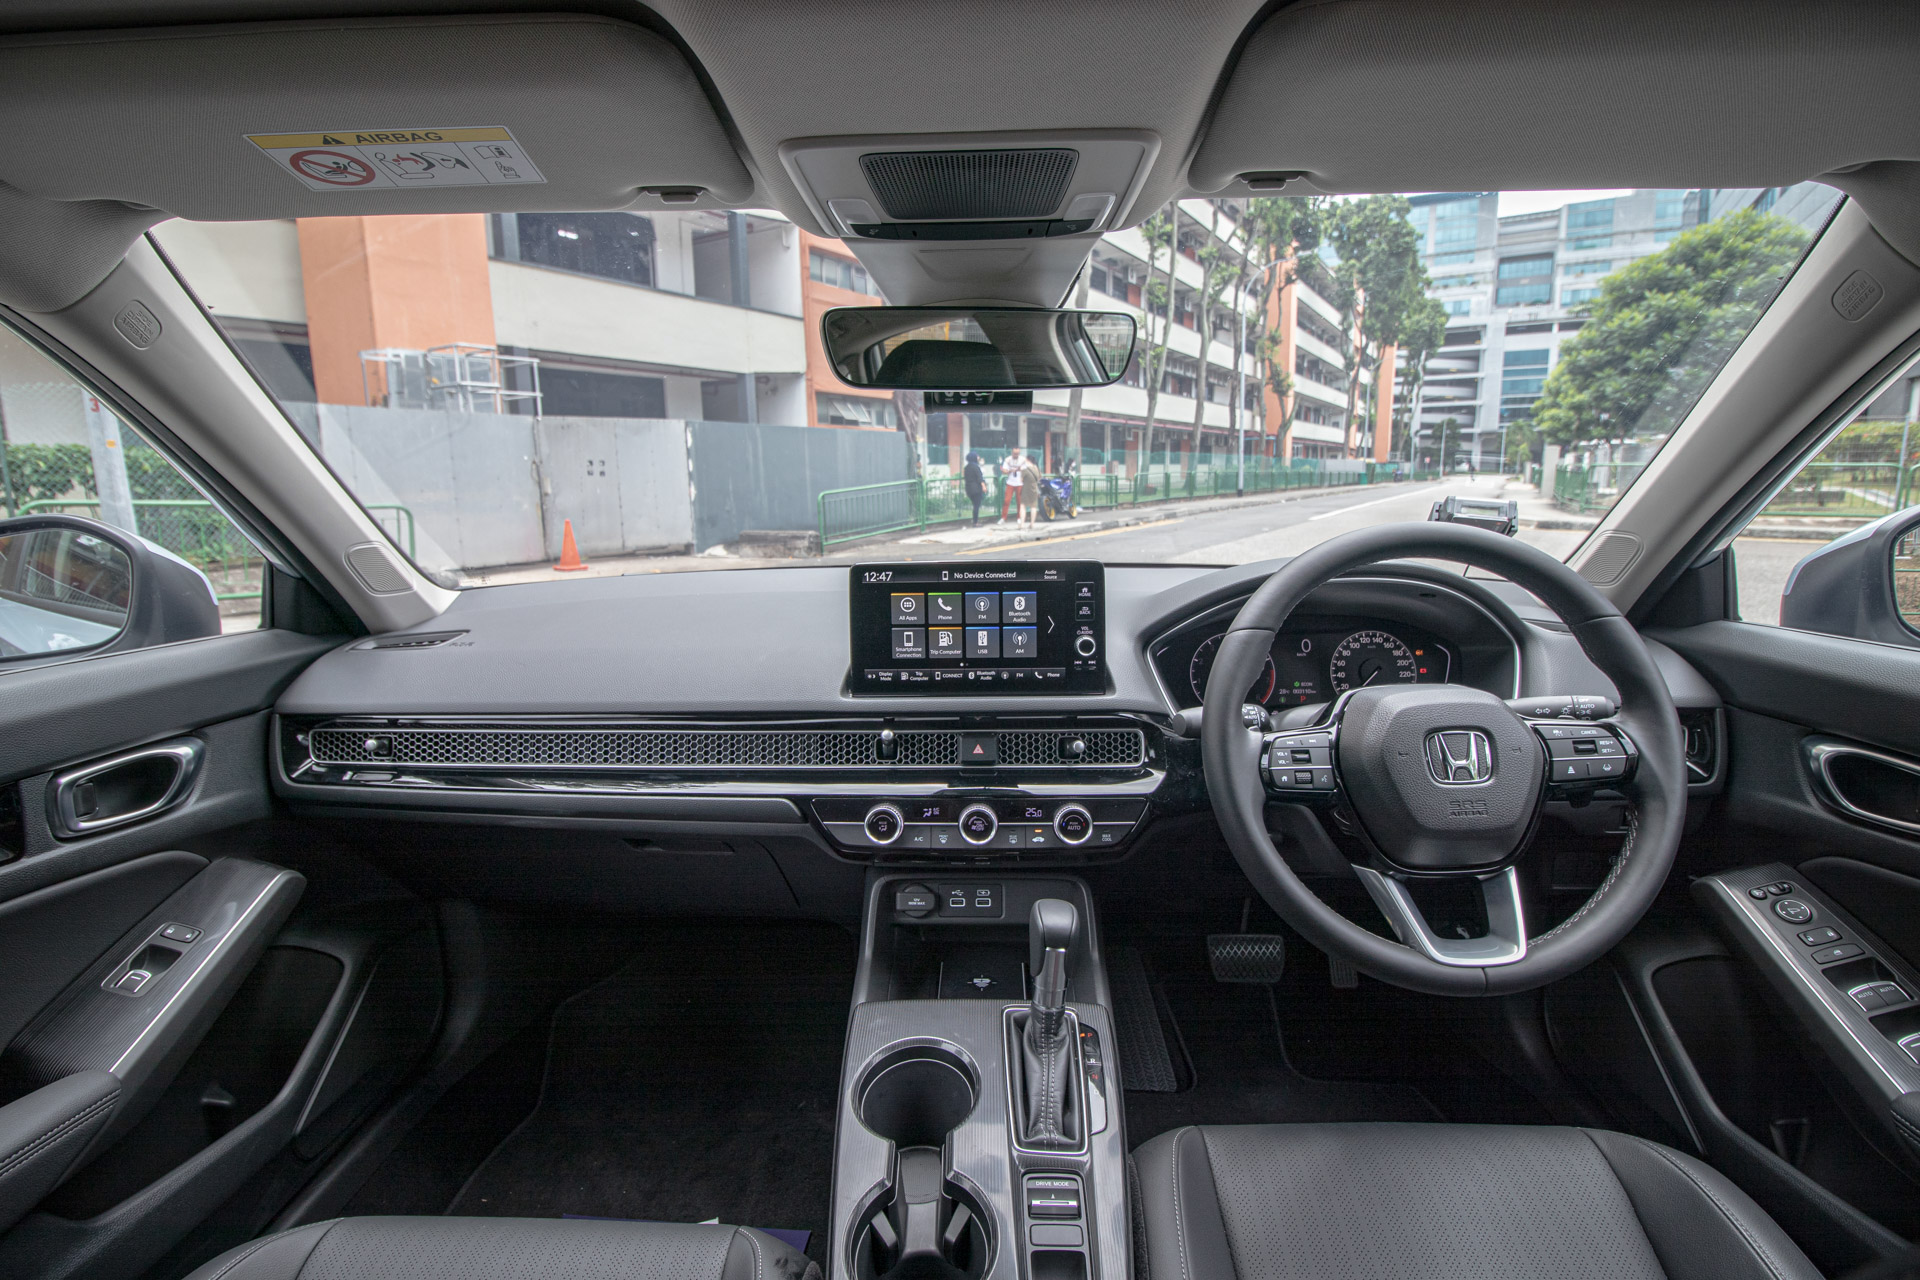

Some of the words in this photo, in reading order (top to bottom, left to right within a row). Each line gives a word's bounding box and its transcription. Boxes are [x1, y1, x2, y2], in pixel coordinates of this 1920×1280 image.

[354, 131, 444, 144] AIRBAG
[119, 317, 150, 344] AIRBAG
[864, 572, 892, 582] 12:47
[1301, 639, 1311, 652] 0
[1450, 800, 1488, 810] SRS
[1026, 808, 1042, 817] 25.0
